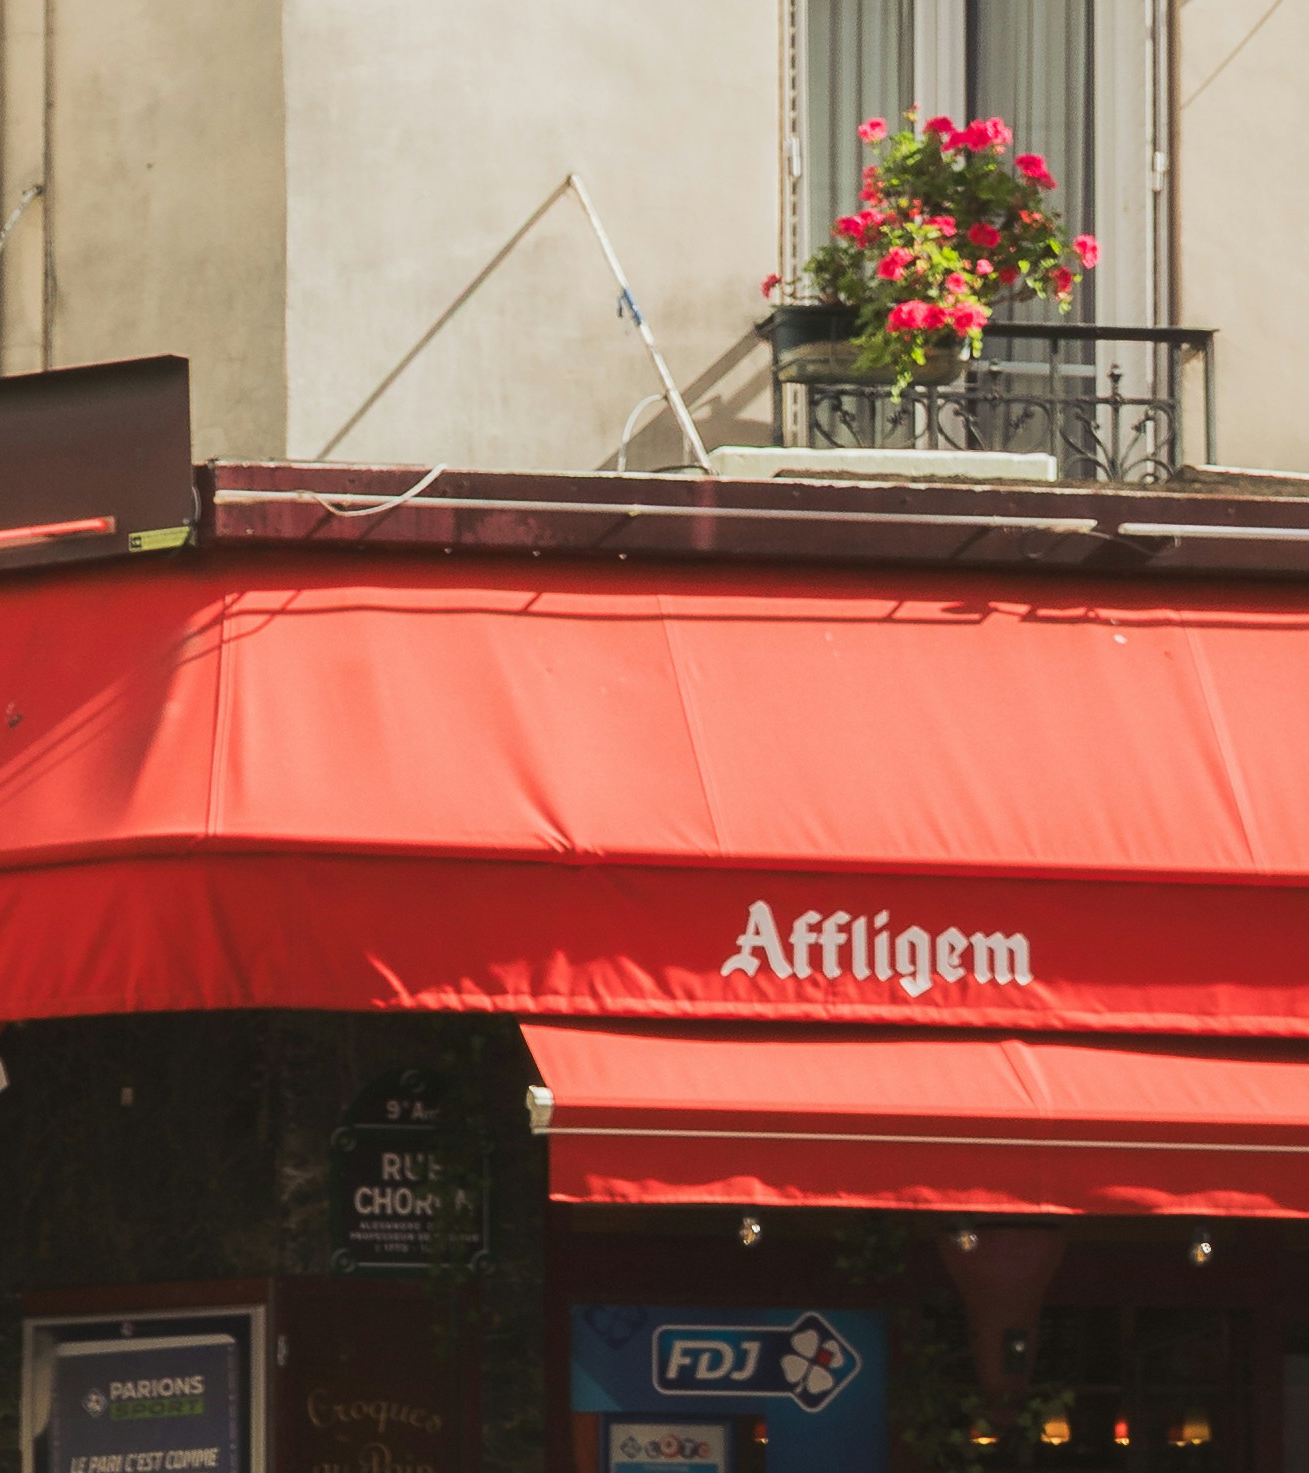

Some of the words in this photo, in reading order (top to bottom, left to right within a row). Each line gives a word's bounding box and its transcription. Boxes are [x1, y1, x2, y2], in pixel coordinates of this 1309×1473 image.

[720, 899, 1034, 999] Affligem
[665, 1339, 760, 1381] FDJ
[109, 1375, 203, 1399] PARIONS
[115, 1400, 199, 1417] SPORT
[306, 1388, 444, 1435] Croques
[124, 1451, 164, 1473] C'EST
[165, 1447, 219, 1469] COMME
